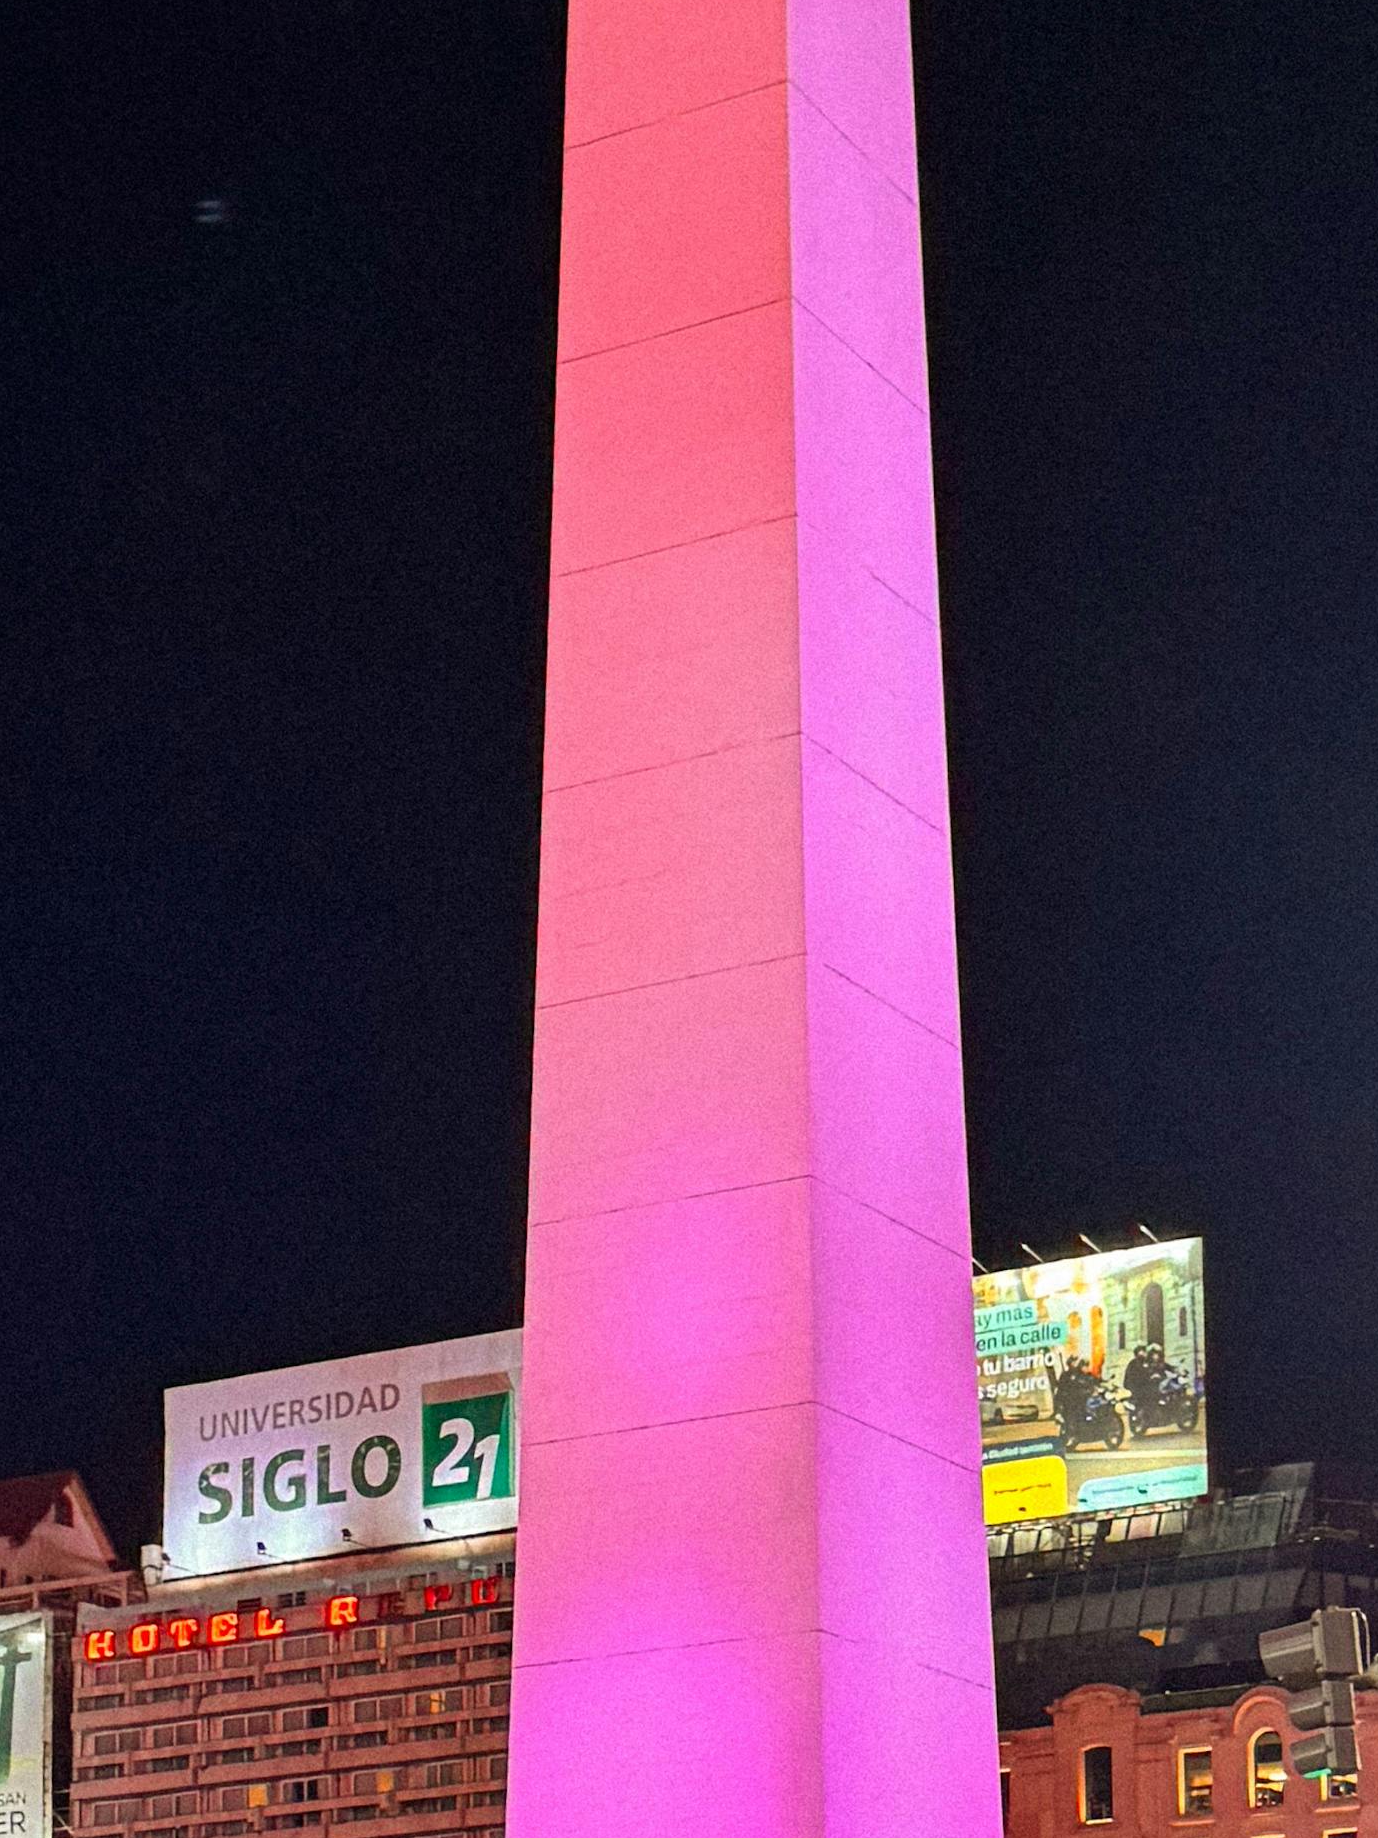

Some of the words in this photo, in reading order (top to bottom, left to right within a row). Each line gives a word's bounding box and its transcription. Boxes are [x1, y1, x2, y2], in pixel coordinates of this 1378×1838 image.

[976, 1337, 998, 1352] en
[1001, 1331, 1017, 1348] la
[1020, 1324, 1061, 1345] calle
[983, 1358, 1001, 1376] tu
[1003, 1352, 1055, 1373] barrio
[986, 1375, 1049, 1399] seguro
[199, 1382, 401, 1442] UNIVERSIDAD
[198, 1434, 402, 1525] SIGLO
[431, 1417, 500, 1500] 21
[84, 1606, 286, 1662] HOTEL
